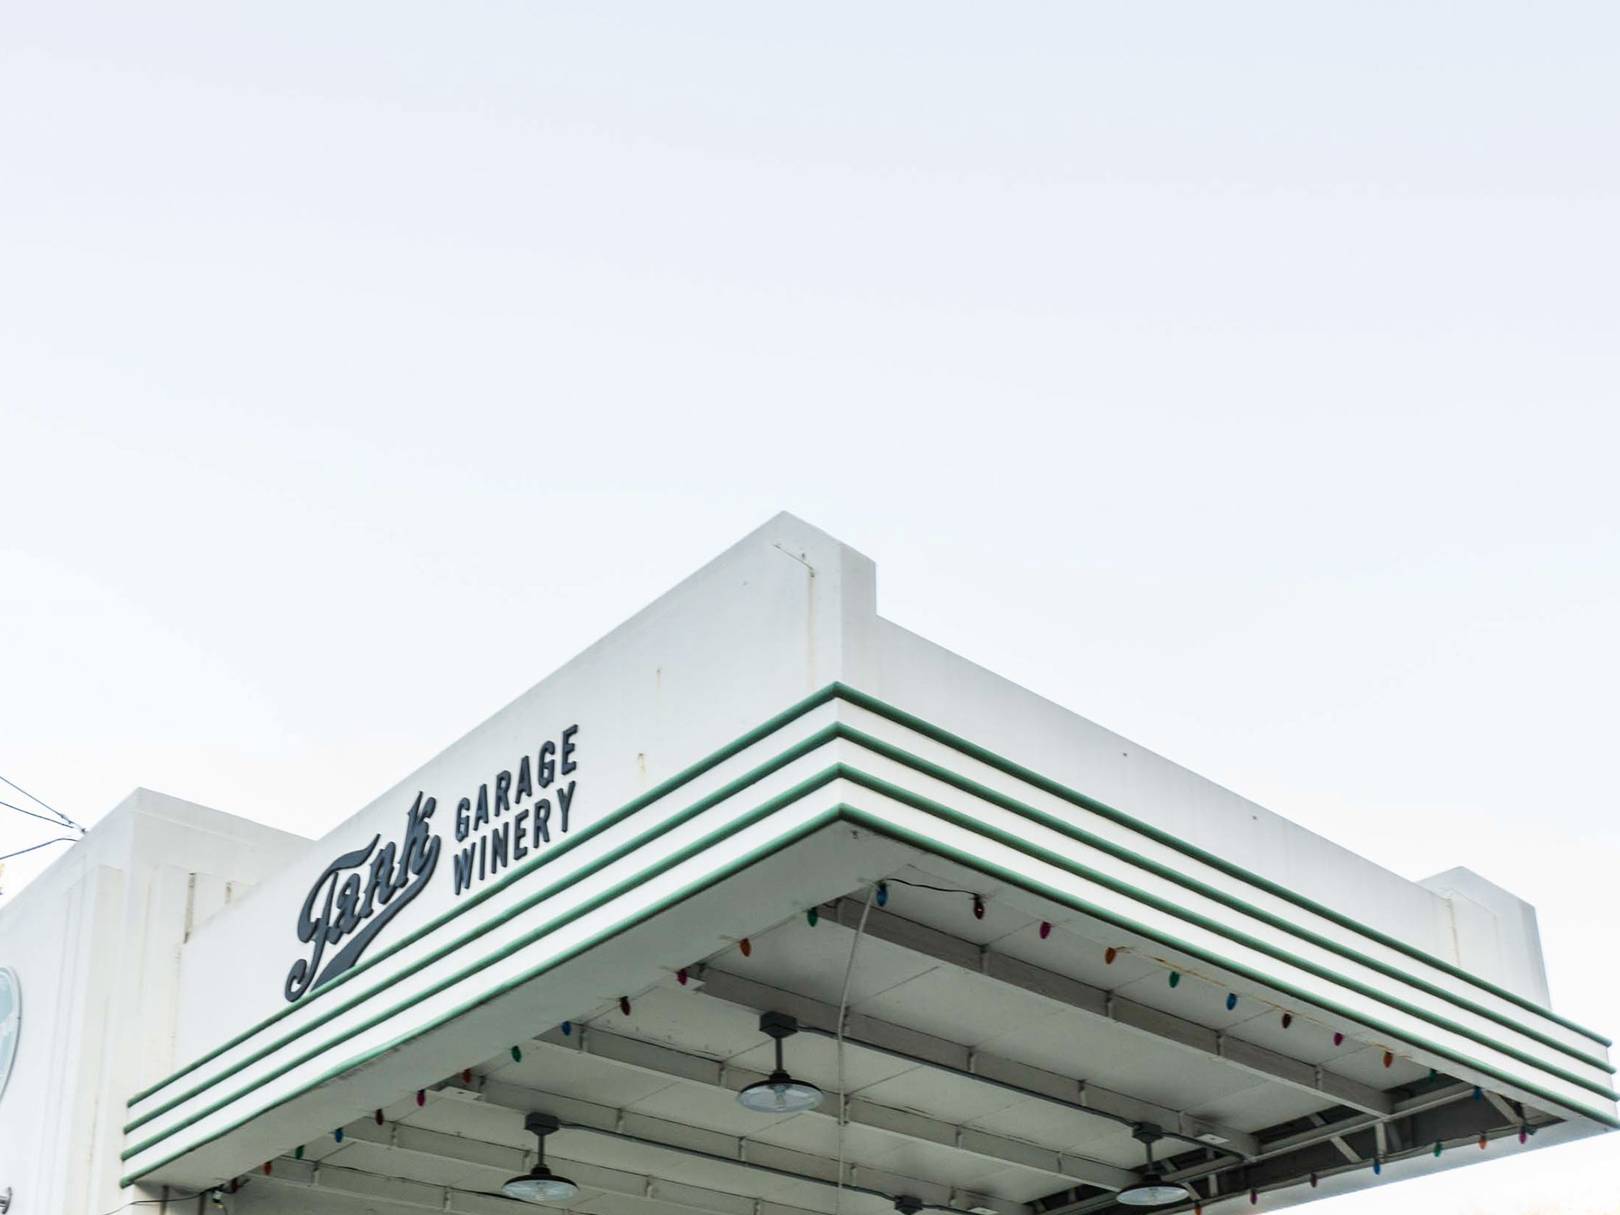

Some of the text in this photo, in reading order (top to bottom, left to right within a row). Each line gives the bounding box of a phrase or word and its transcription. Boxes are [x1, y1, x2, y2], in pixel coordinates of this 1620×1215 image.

[453, 780, 577, 896] WINERY
[455, 724, 579, 842] GARAGE
[284, 790, 441, 1002] Tank
